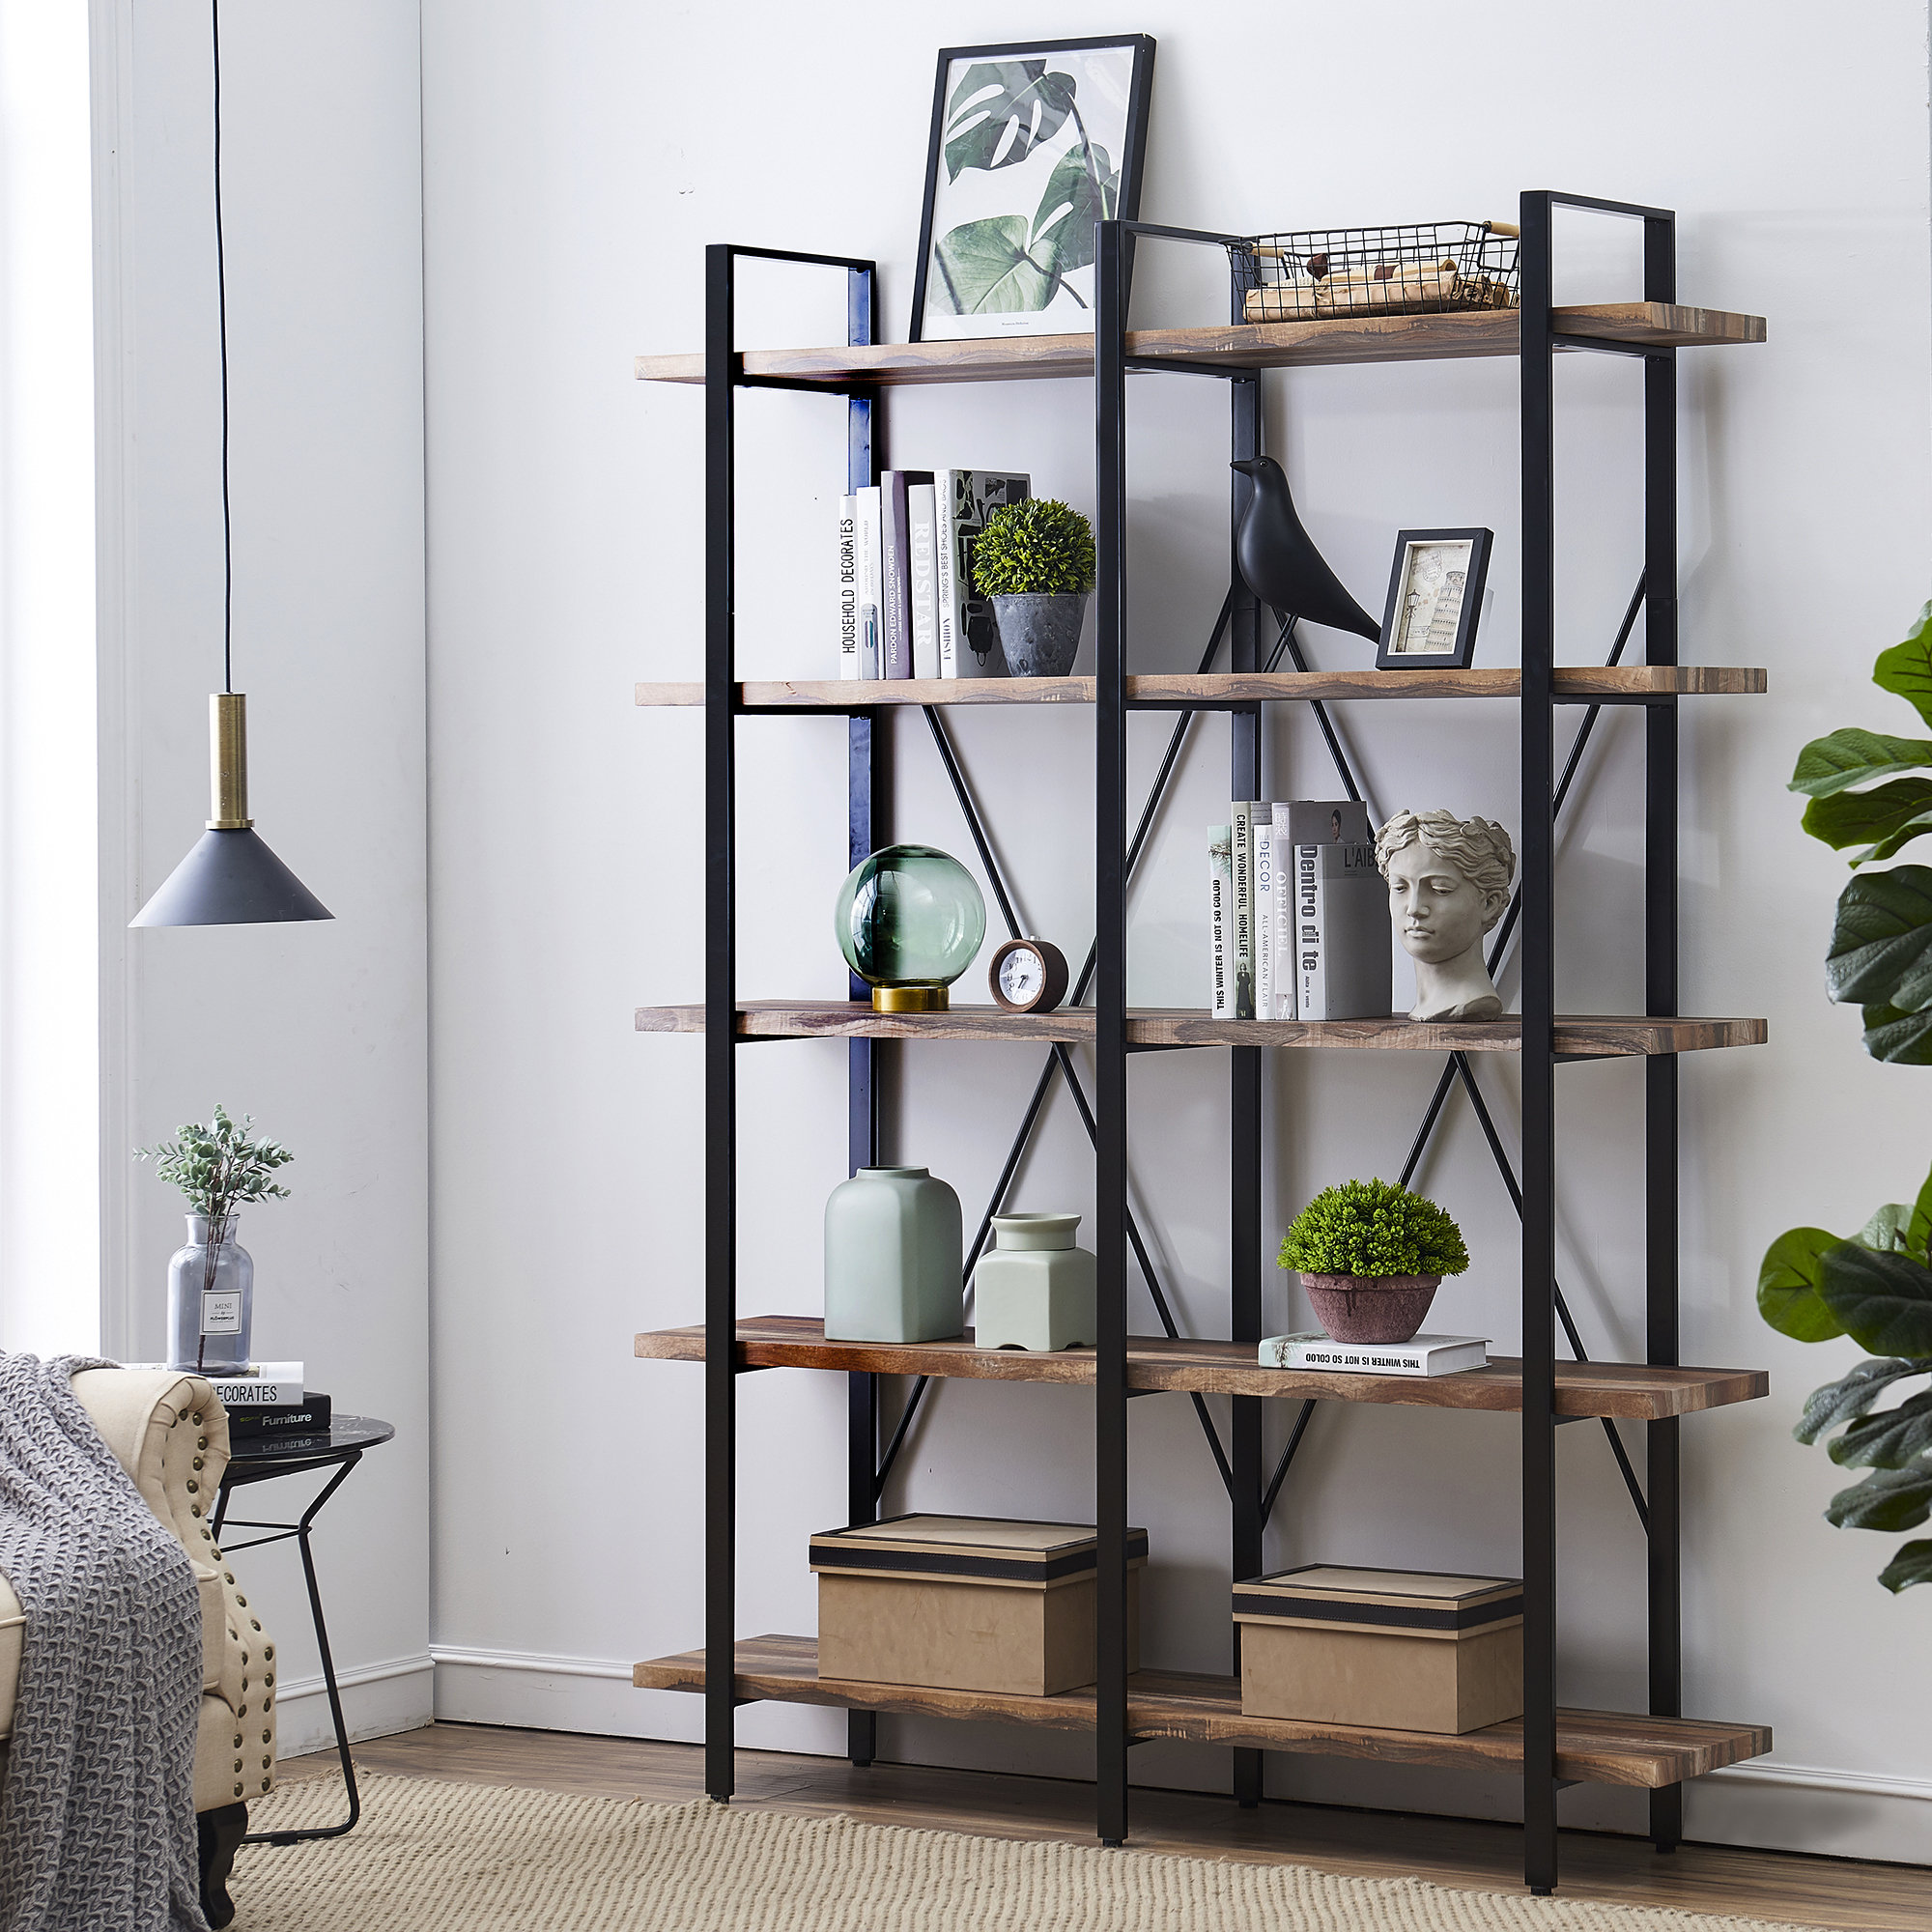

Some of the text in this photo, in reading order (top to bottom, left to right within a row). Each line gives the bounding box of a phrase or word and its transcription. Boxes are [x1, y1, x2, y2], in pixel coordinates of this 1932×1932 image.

[840, 518, 855, 582] DECORATES
[887, 545, 897, 664] PARDON EDWARD SNOWDEN
[914, 521, 932, 646] REDSTAR
[841, 589, 855, 653] HOUSEHOLD
[943, 618, 951, 660] FASHION
[1236, 814, 1248, 958] CREATE WONDERFUL HOMELIFE
[1259, 841, 1270, 892] DECOR
[1301, 846, 1319, 971] Dentro di te
[1212, 879, 1224, 1010] THIS WINTER IS NOT SO COLOD
[1305, 1353, 1420, 1368] THIS WINTER IS NOT SO COLOD
[213, 1385, 277, 1402] ECORATES
[262, 1413, 312, 1426] Furniture
